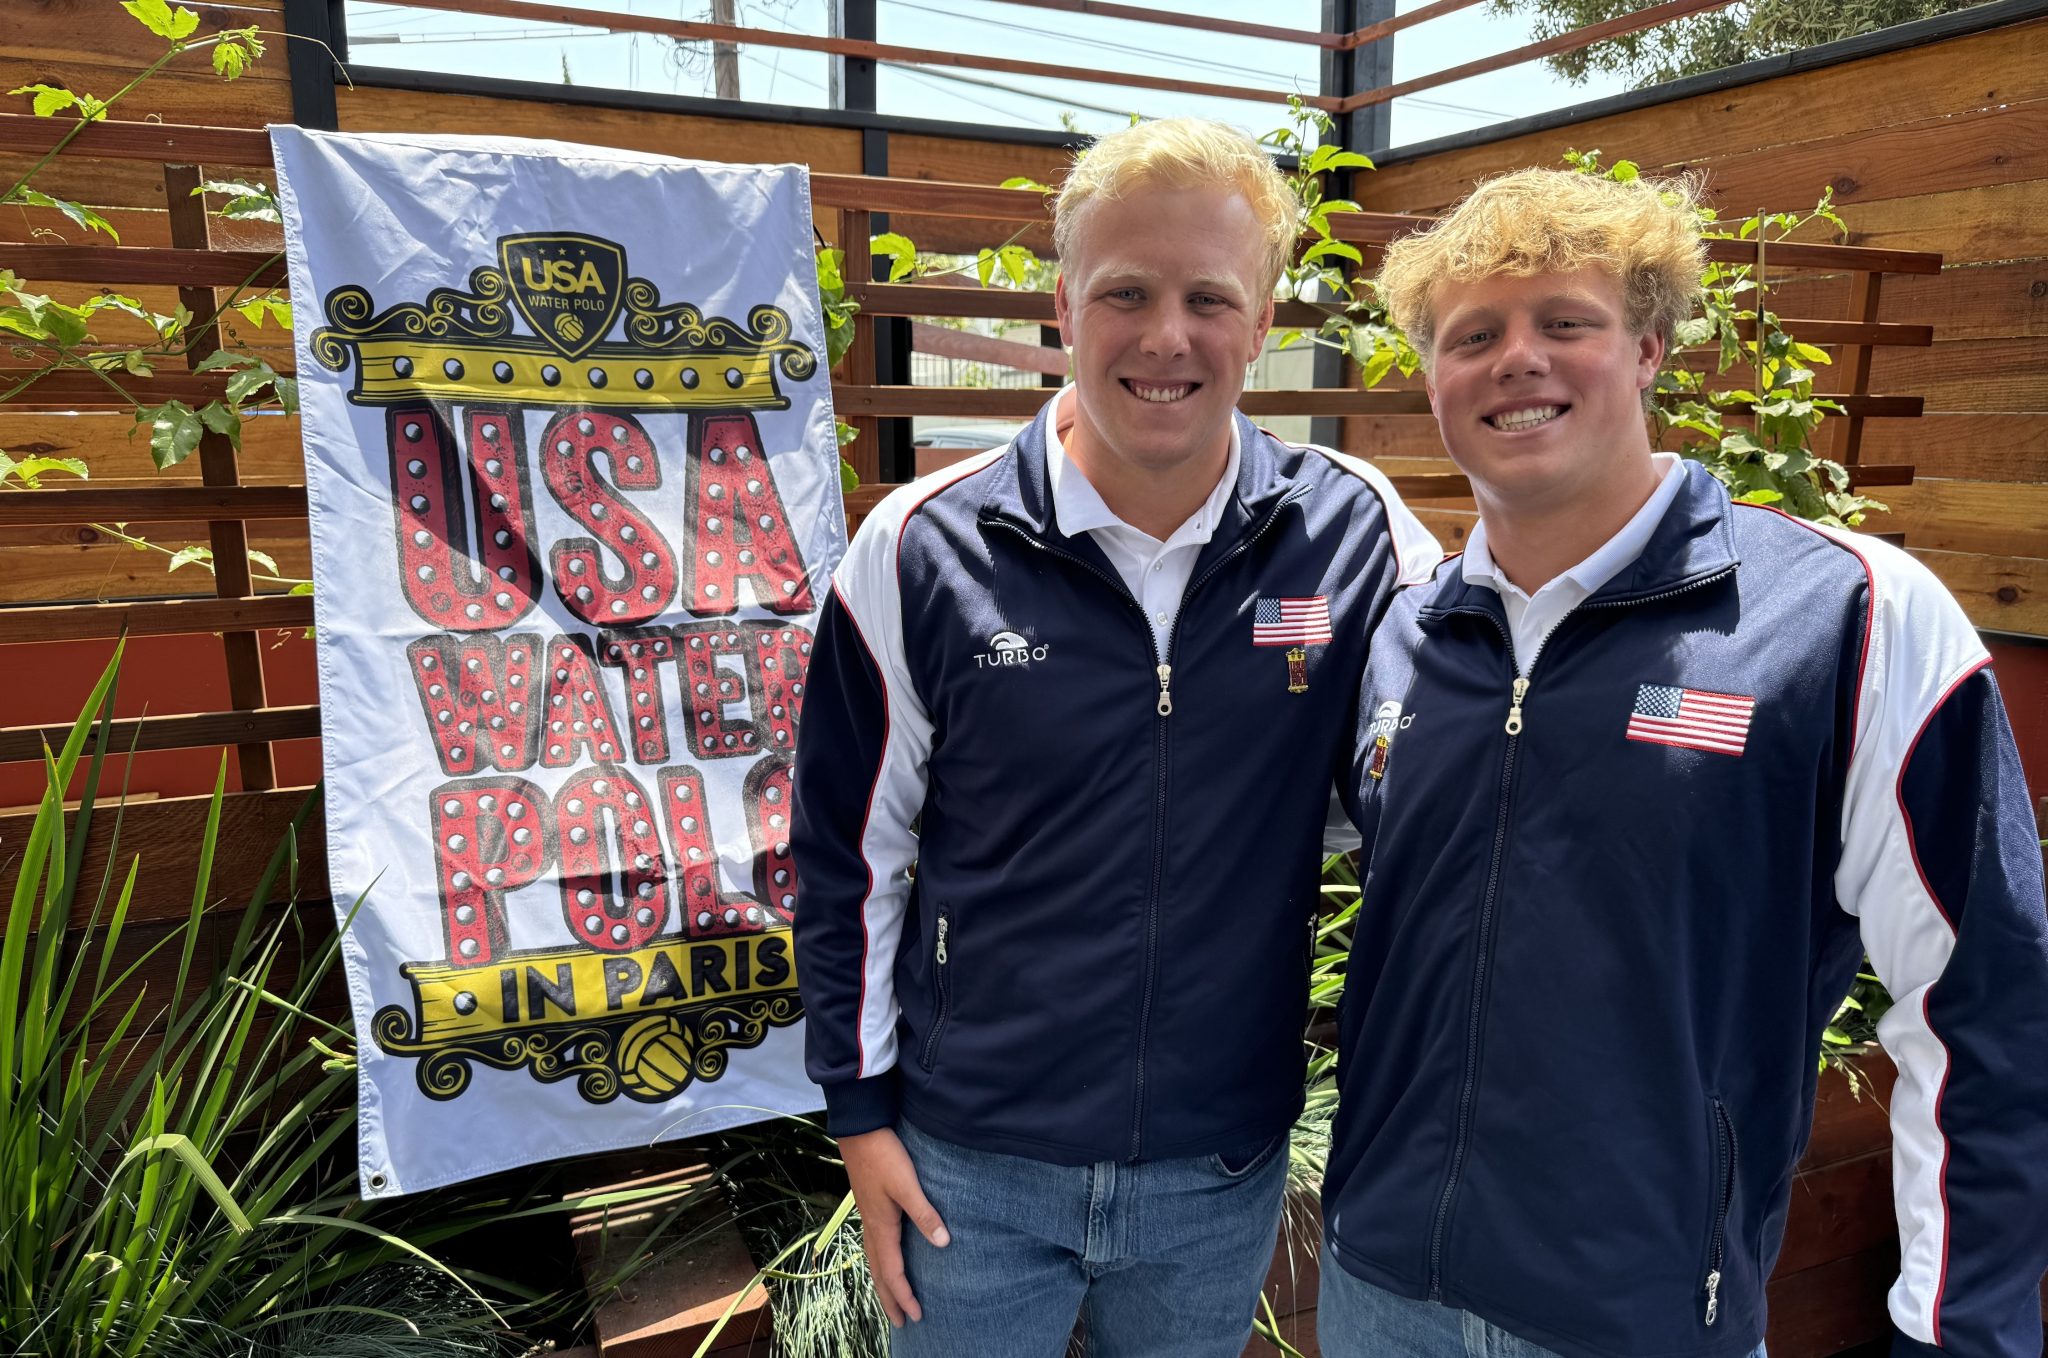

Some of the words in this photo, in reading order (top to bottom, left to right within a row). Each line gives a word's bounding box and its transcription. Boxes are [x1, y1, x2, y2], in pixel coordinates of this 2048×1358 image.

[522, 256, 606, 294] USA
[528, 295, 570, 310] WATER
[574, 299, 605, 312] POLO
[386, 404, 816, 630] USA
[973, 647, 1047, 669] TURBO
[406, 619, 816, 776] WATER
[500, 963, 577, 1023] IN
[603, 936, 790, 1011] PARIS
